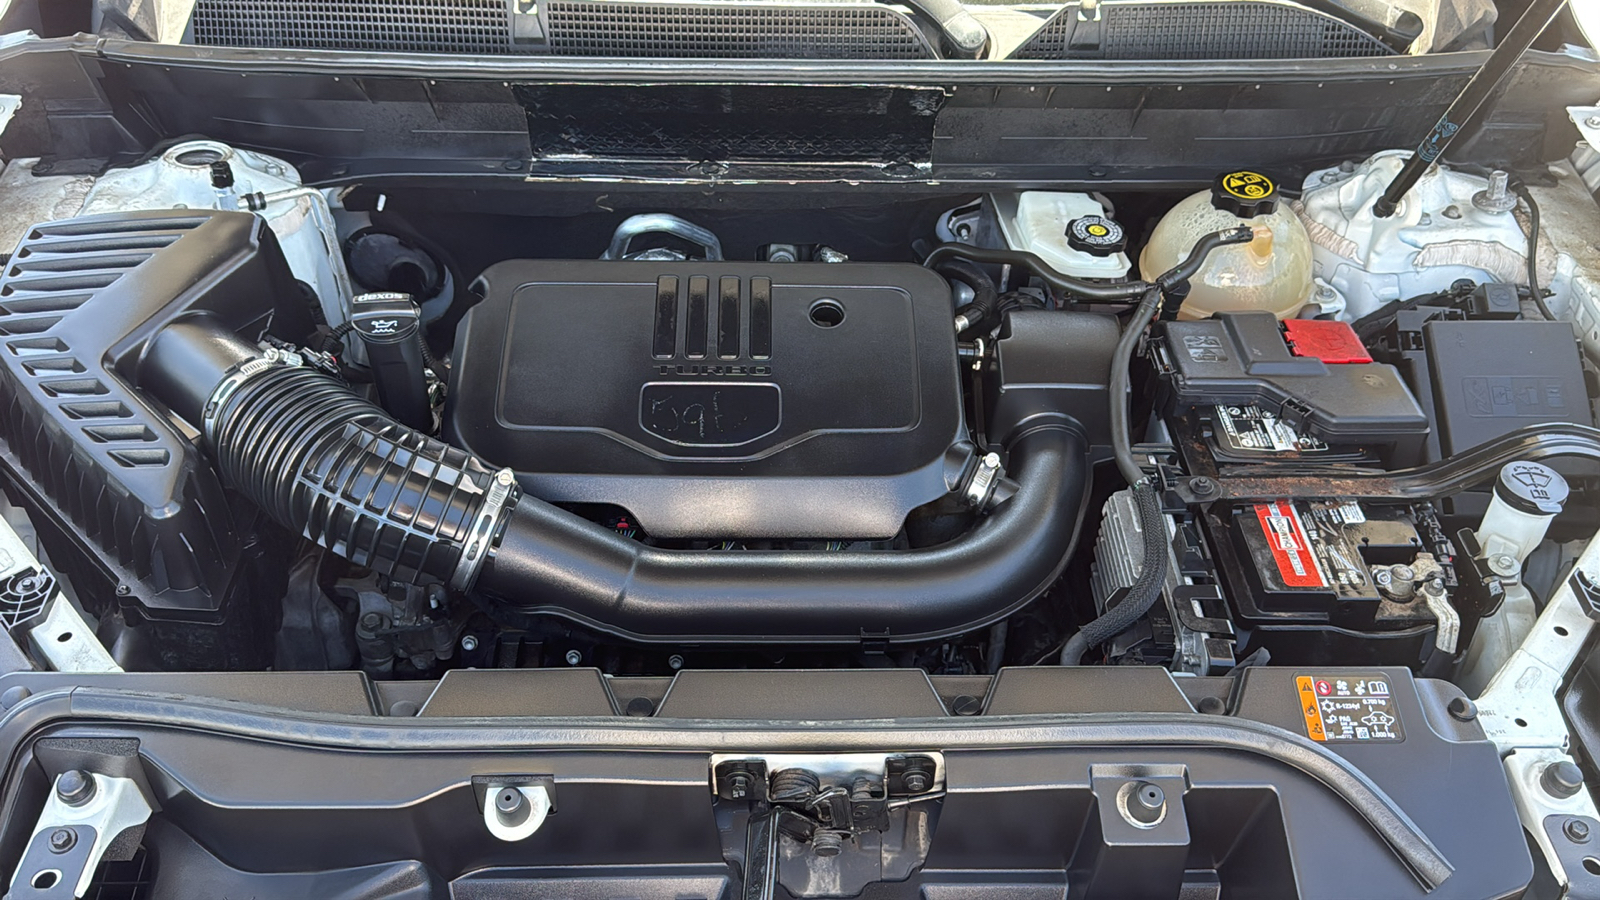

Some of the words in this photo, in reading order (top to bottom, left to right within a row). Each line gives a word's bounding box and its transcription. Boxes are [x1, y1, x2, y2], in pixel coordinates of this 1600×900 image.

[357, 293, 403, 302] dexos
[653, 364, 772, 377] TURBO
[1275, 517, 1294, 549] CHAMPION
